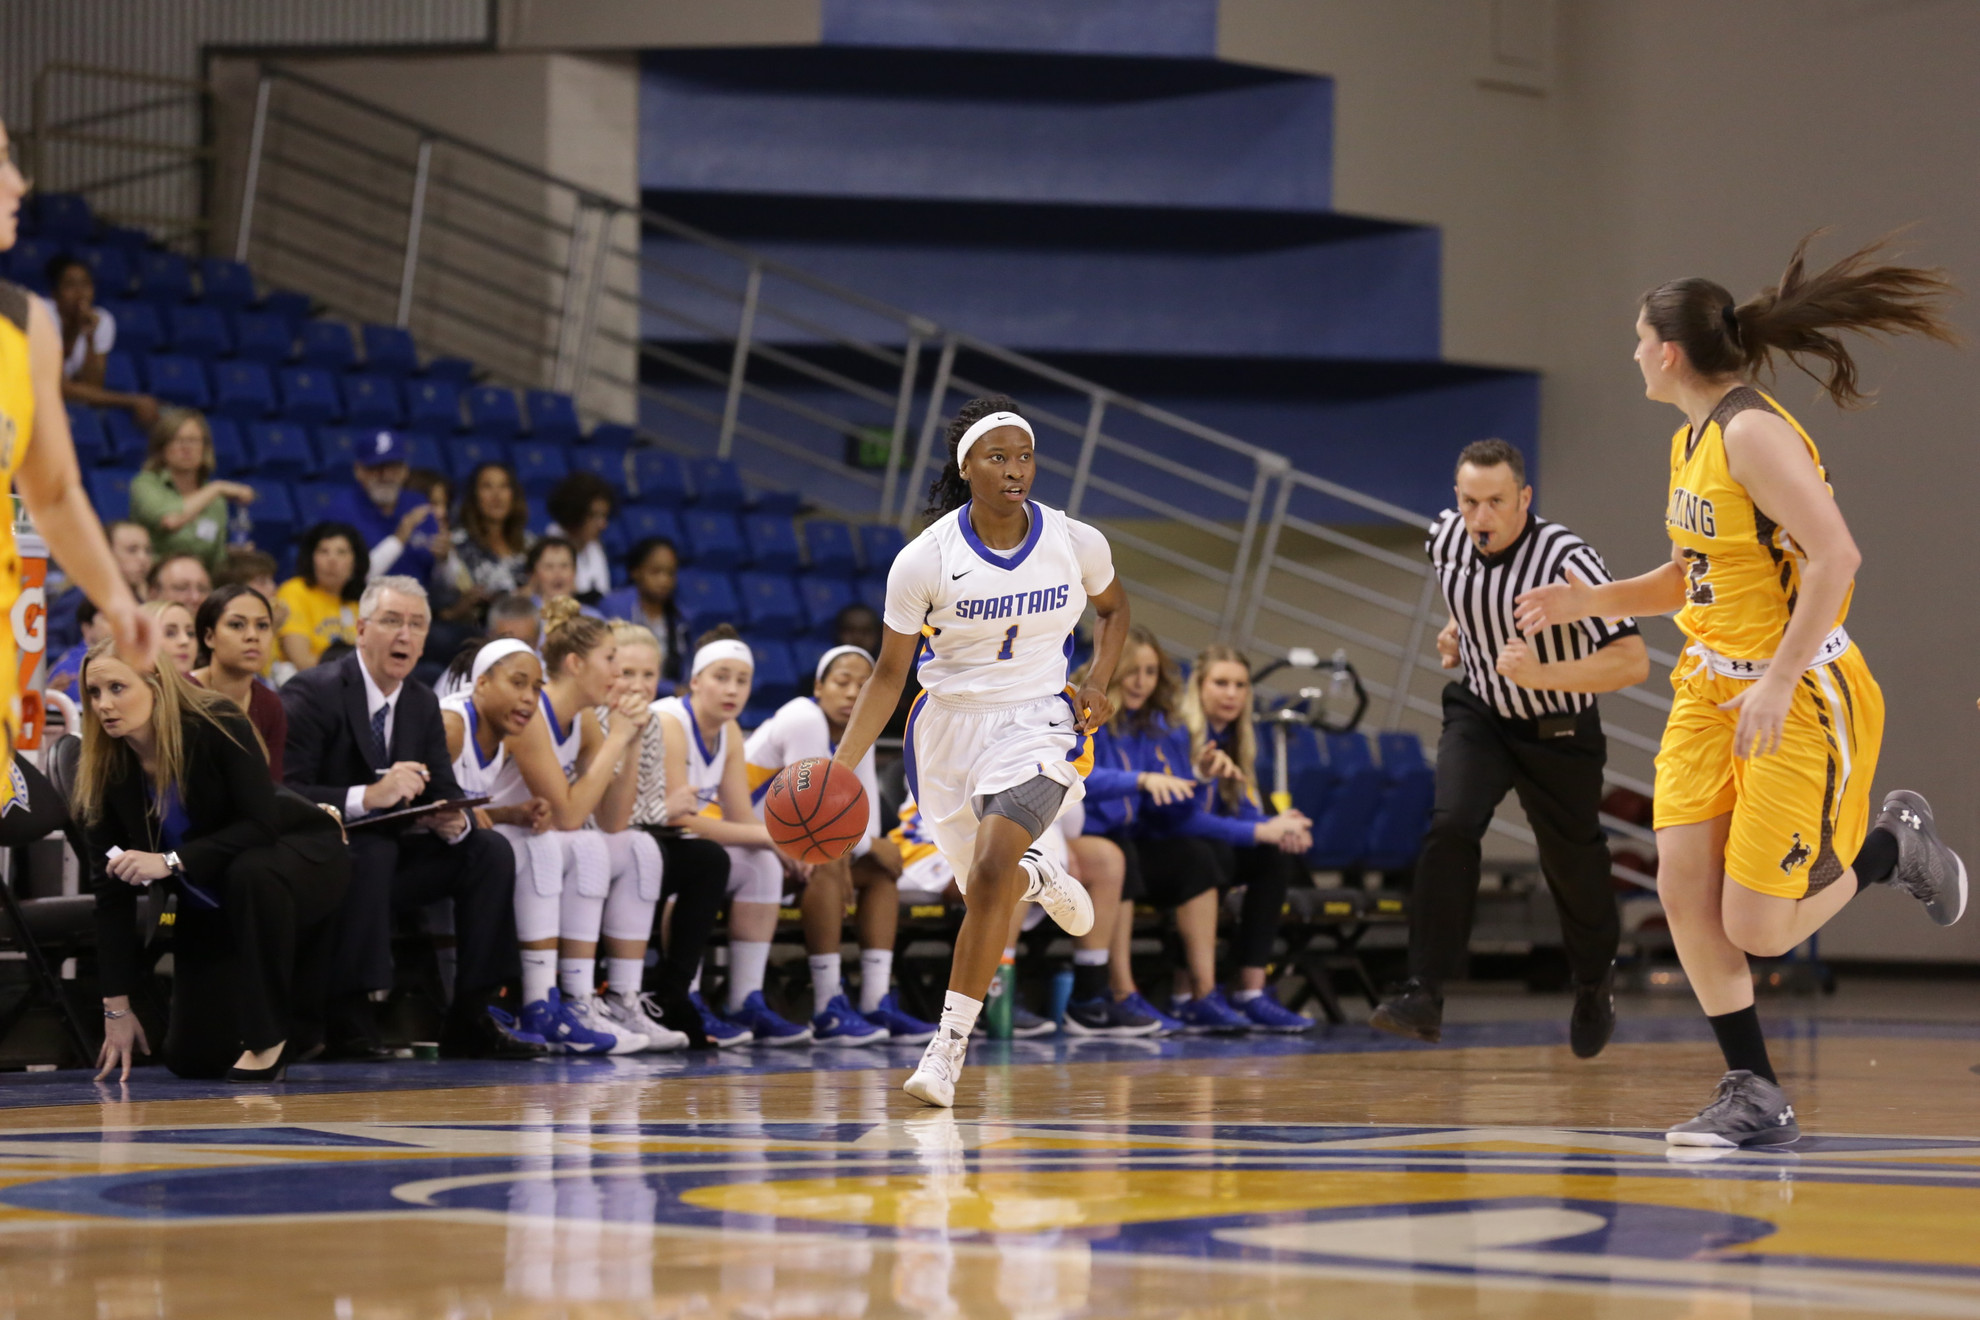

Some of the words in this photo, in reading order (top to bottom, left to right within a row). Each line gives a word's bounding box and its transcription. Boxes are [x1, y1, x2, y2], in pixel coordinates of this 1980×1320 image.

[1667, 487, 1716, 539] MING
[955, 584, 1069, 620] SPARTANS
[997, 624, 1019, 661] 1
